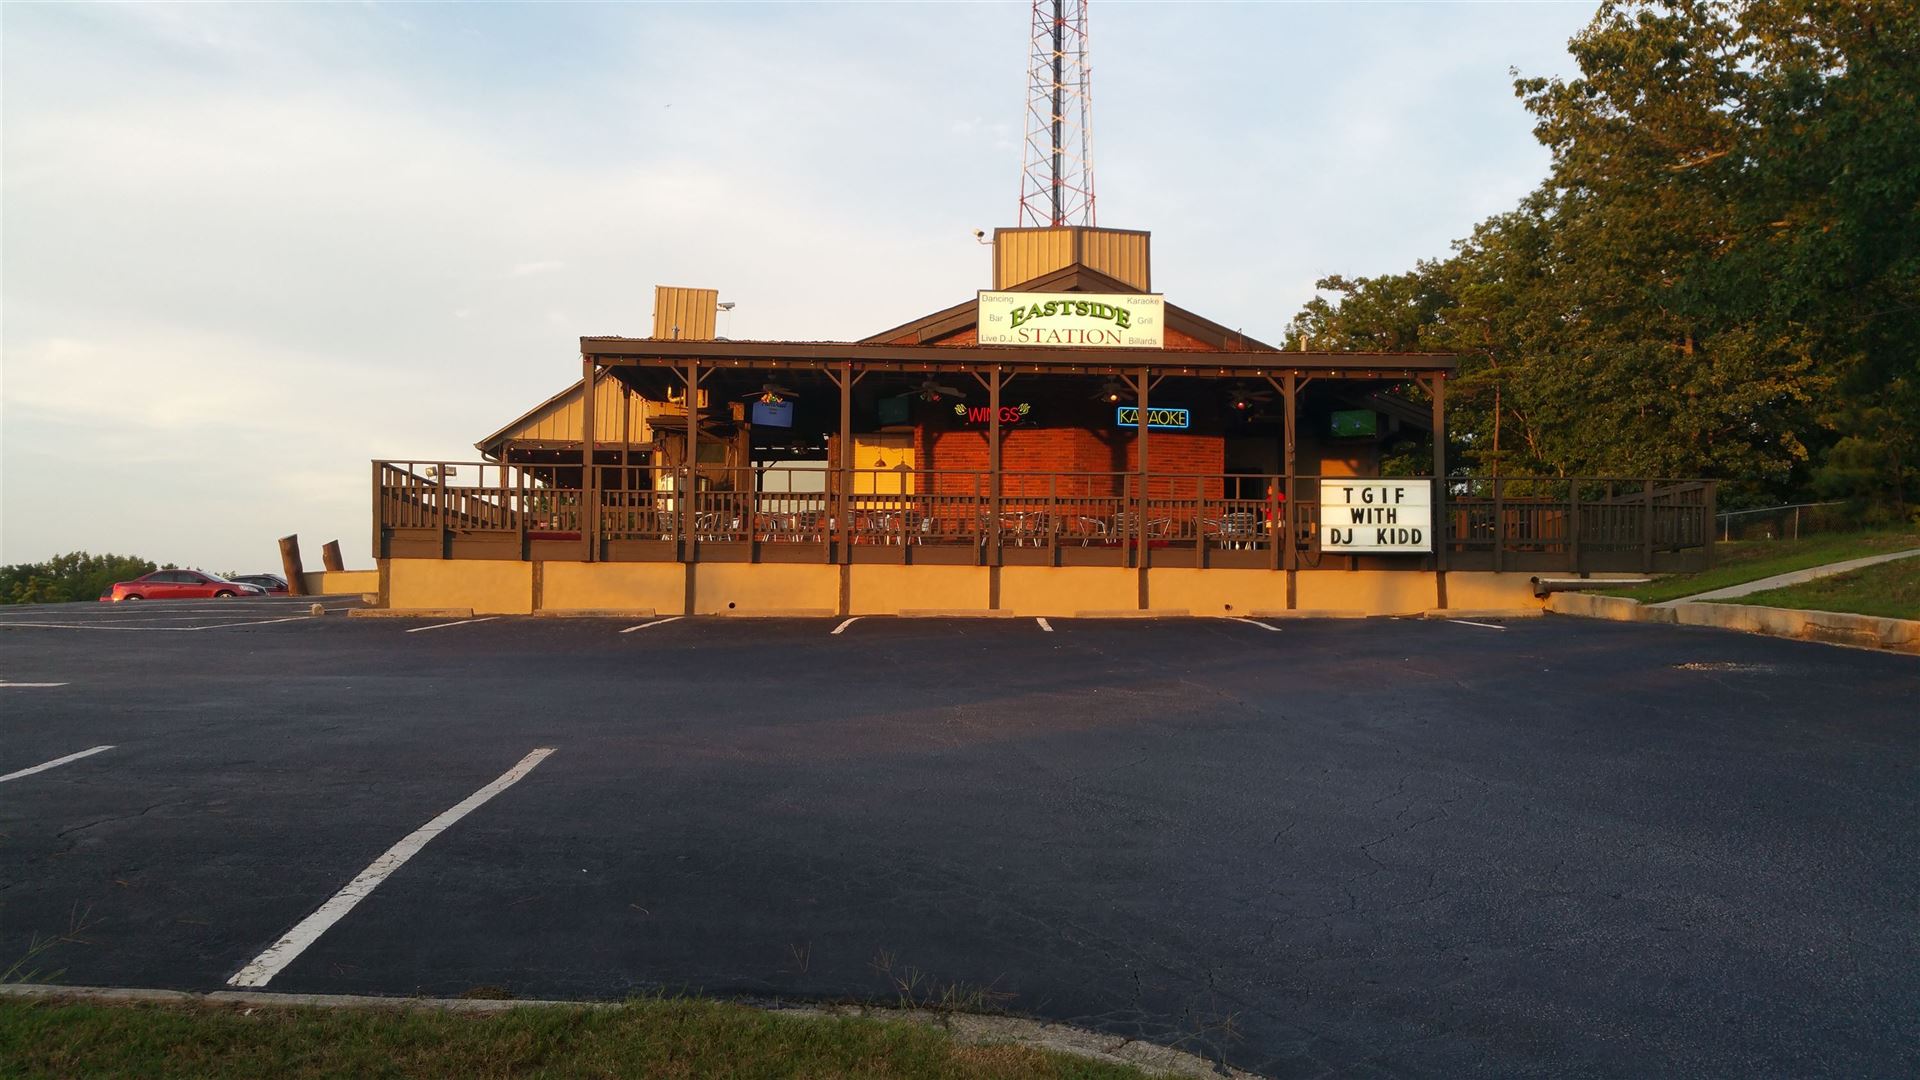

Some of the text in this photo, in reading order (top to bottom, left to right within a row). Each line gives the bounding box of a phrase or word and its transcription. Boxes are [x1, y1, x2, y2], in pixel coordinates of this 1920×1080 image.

[981, 294, 1014, 304] Dancing
[1127, 297, 1160, 305] Karaoke
[989, 314, 1003, 322] Bar
[1010, 300, 1131, 329] EASTSIDE
[1137, 317, 1153, 325] Grill
[981, 334, 998, 342] Live
[1018, 327, 1122, 344] STATION
[1120, 409, 1186, 426] KAAOKE
[1350, 508, 1397, 524] WITH
[1330, 528, 1422, 545] DJ KIDD
